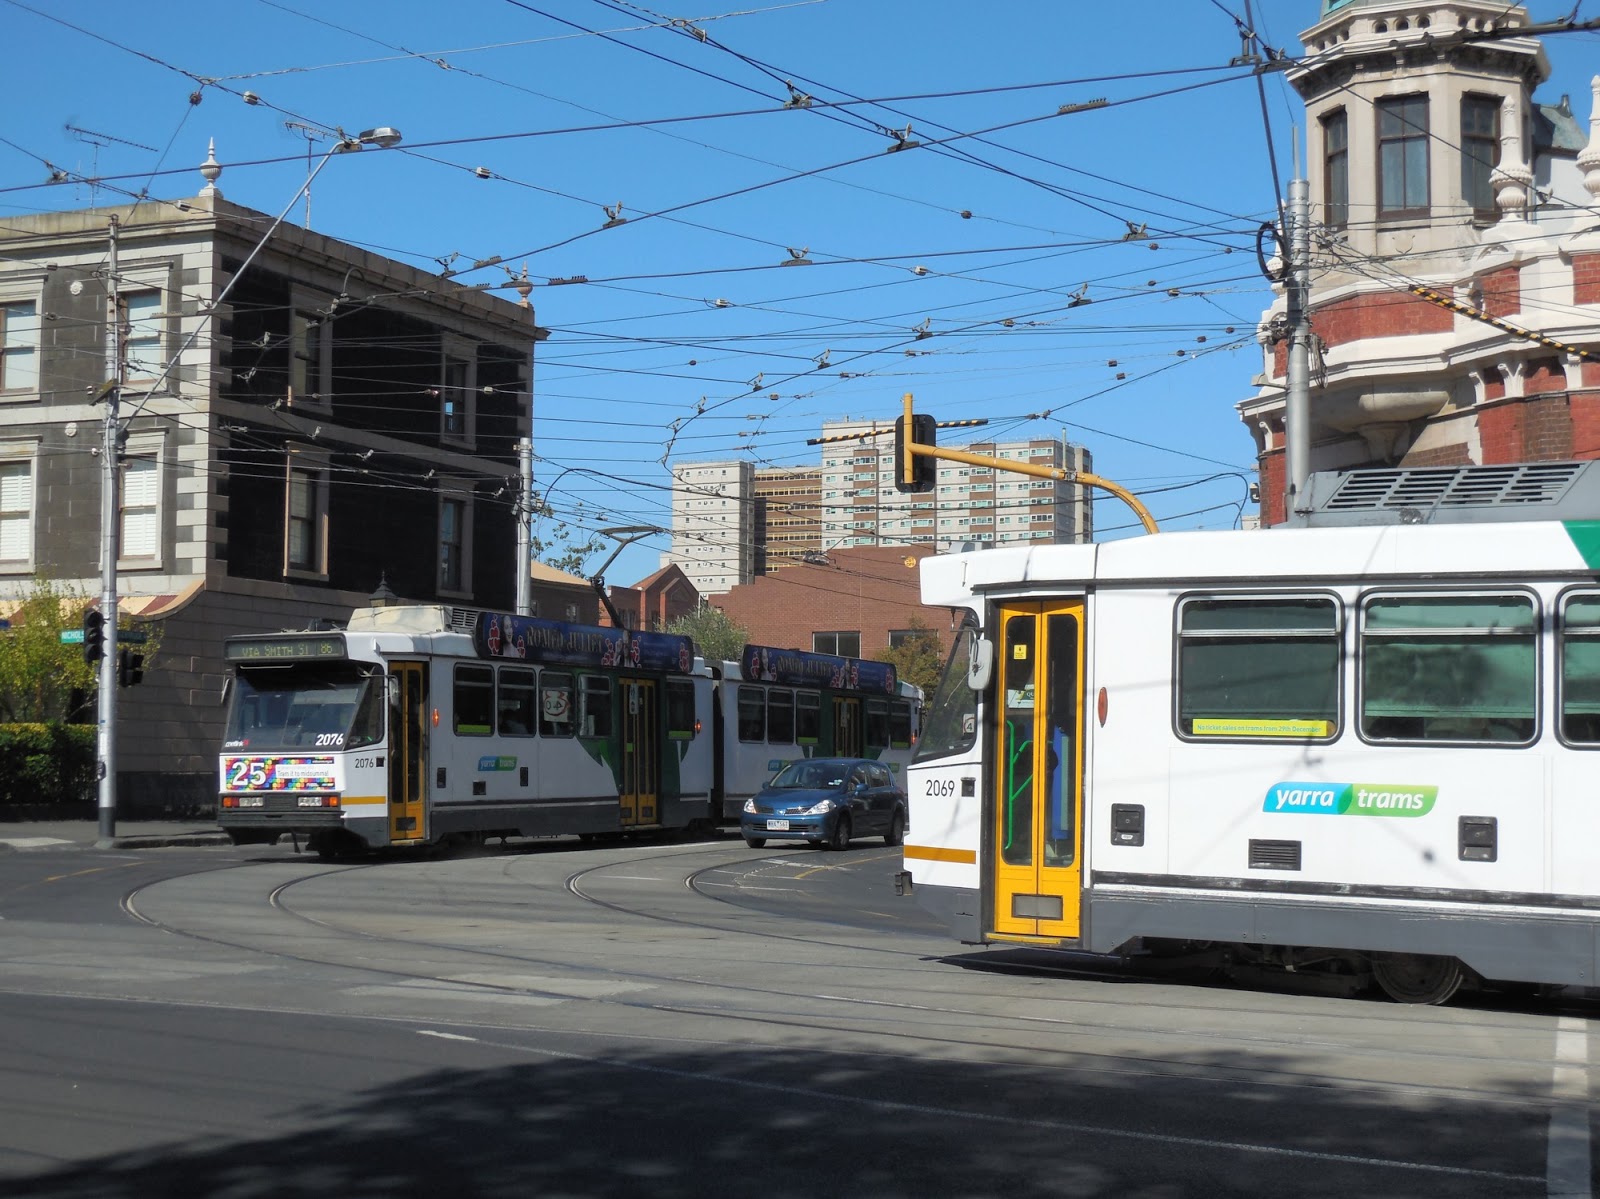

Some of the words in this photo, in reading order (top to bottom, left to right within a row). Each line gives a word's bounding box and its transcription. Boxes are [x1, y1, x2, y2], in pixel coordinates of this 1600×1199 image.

[264, 644, 293, 656] SMITH
[315, 733, 344, 746] 2076
[354, 758, 374, 769] 2076
[232, 761, 267, 786] 25
[926, 779, 955, 797] 2069
[1275, 789, 1335, 810] yarra
[1357, 788, 1425, 810] trams
